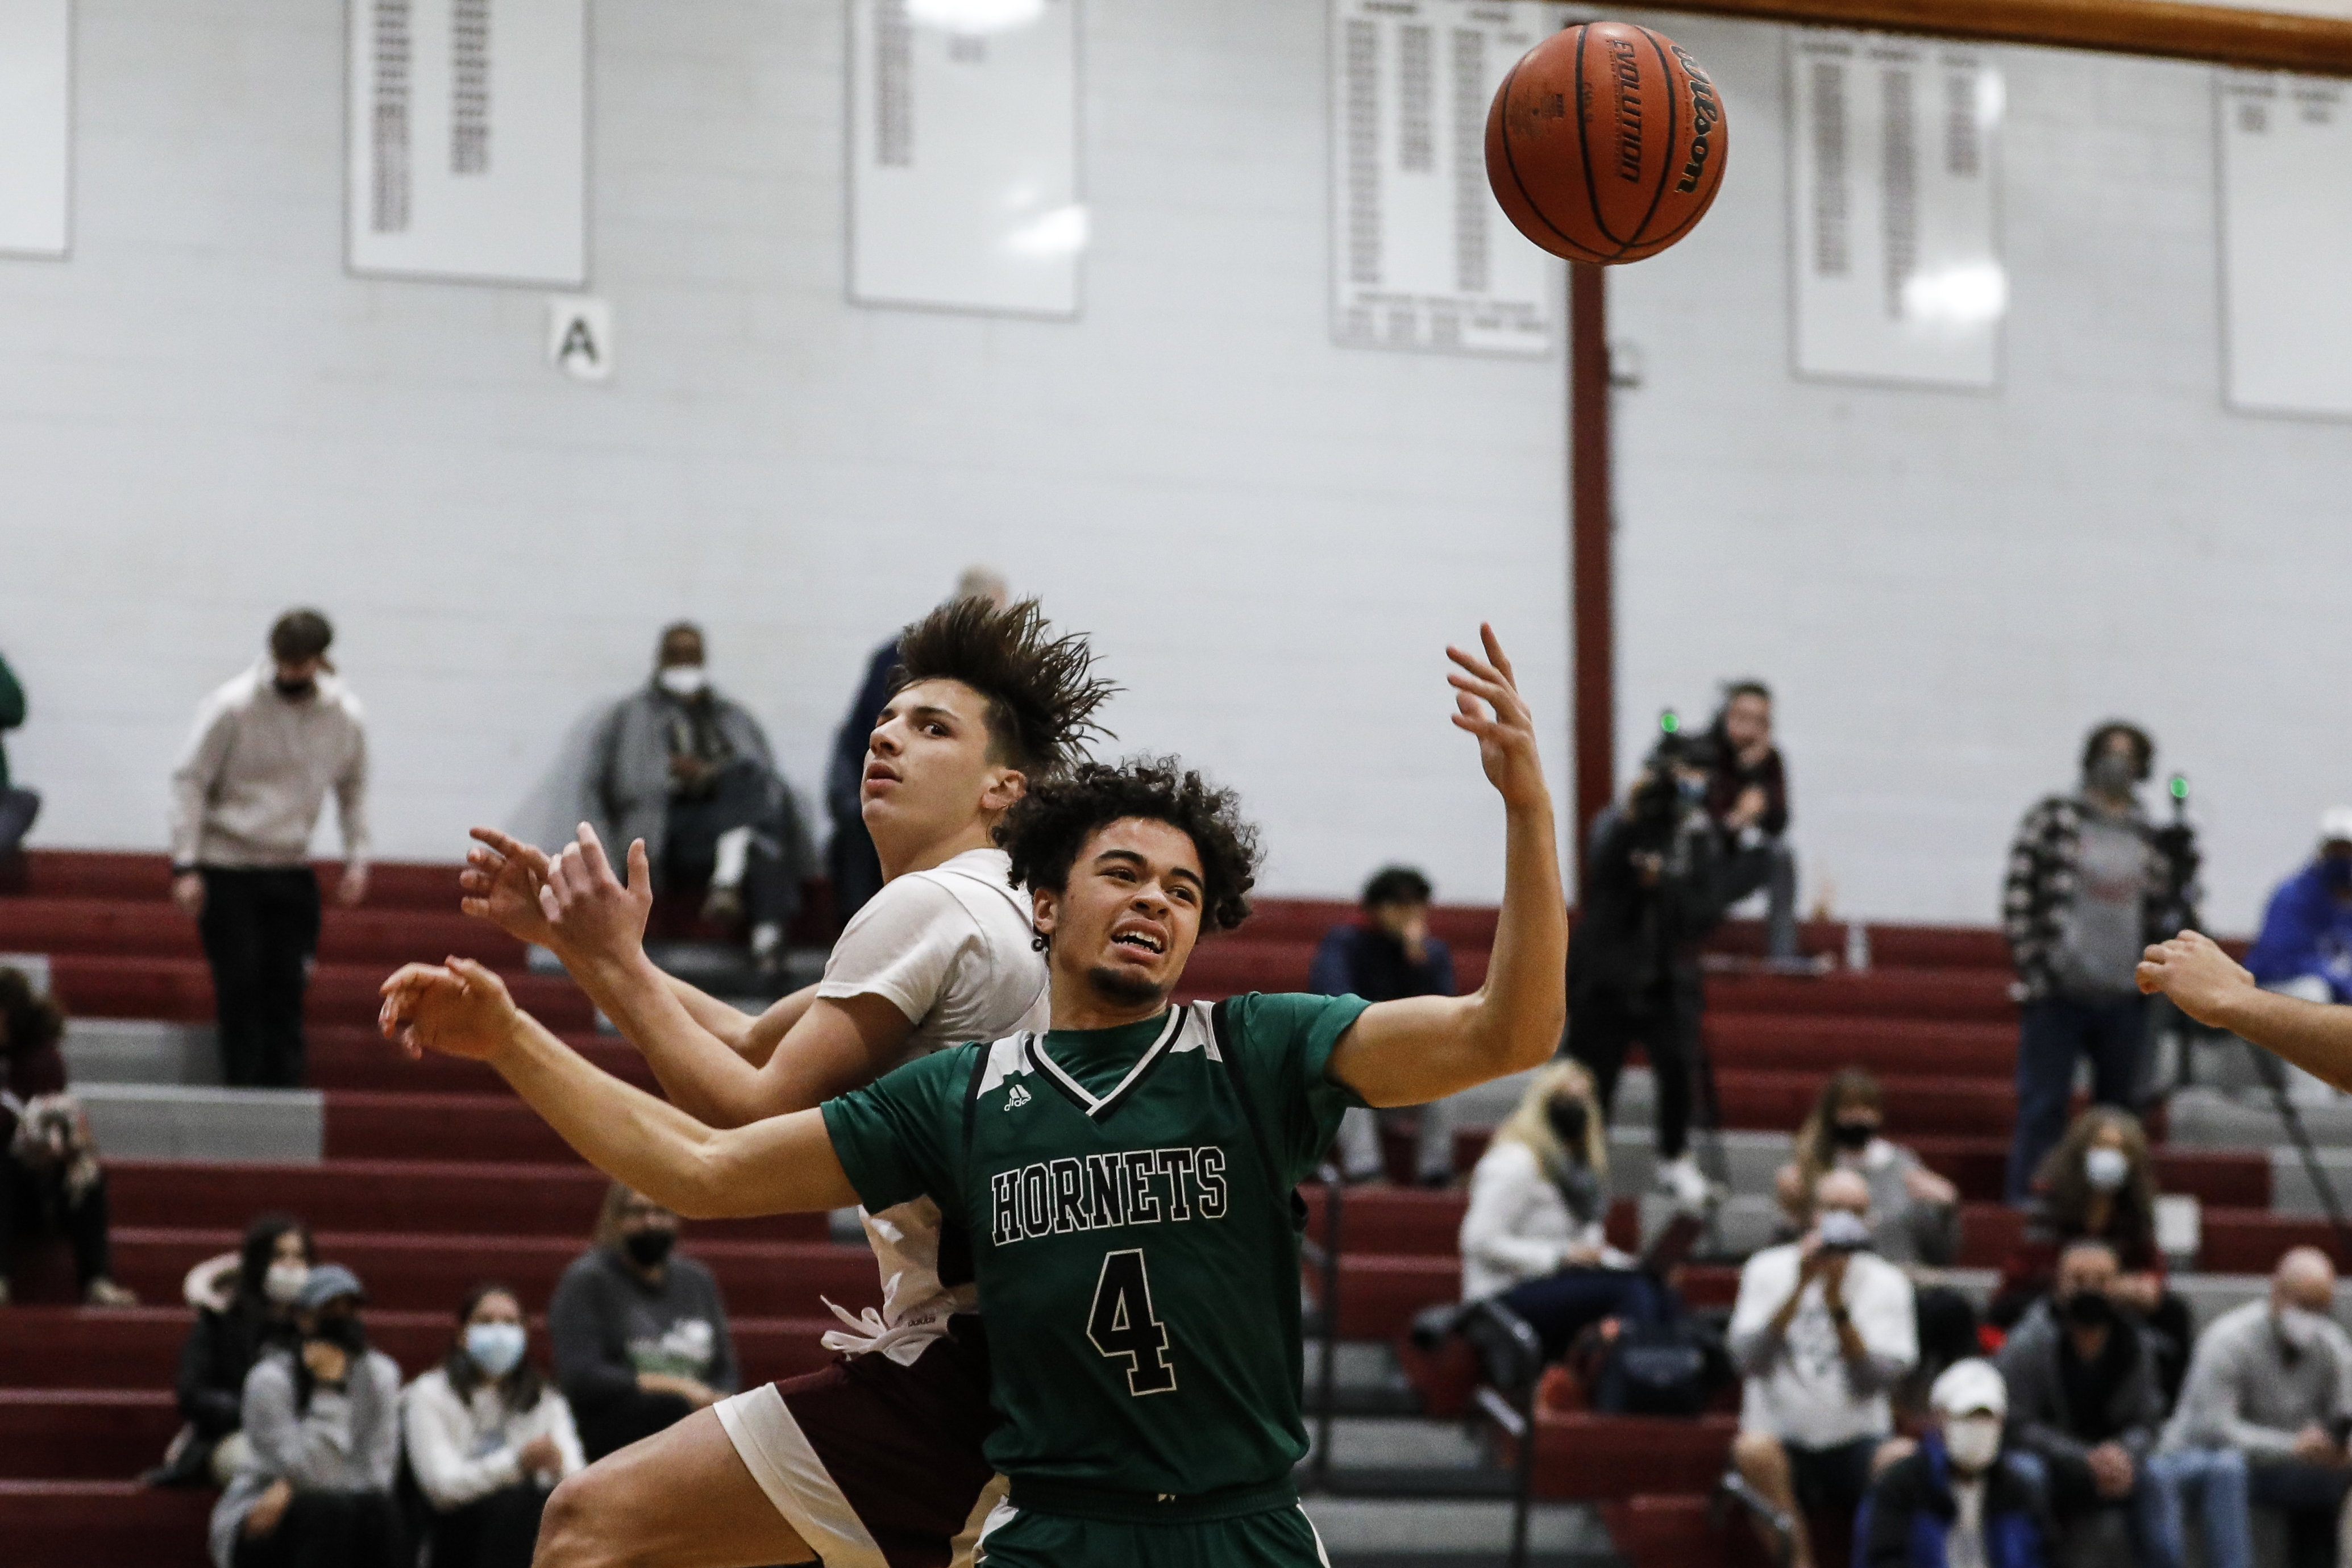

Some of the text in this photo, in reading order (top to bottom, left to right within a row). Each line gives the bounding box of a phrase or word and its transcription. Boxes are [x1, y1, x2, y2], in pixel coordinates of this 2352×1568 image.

[1670, 45, 1718, 194] Wilson
[556, 316, 600, 367] A
[991, 1145, 1228, 1247] HORNETS
[1086, 1247, 1177, 1398] 4
